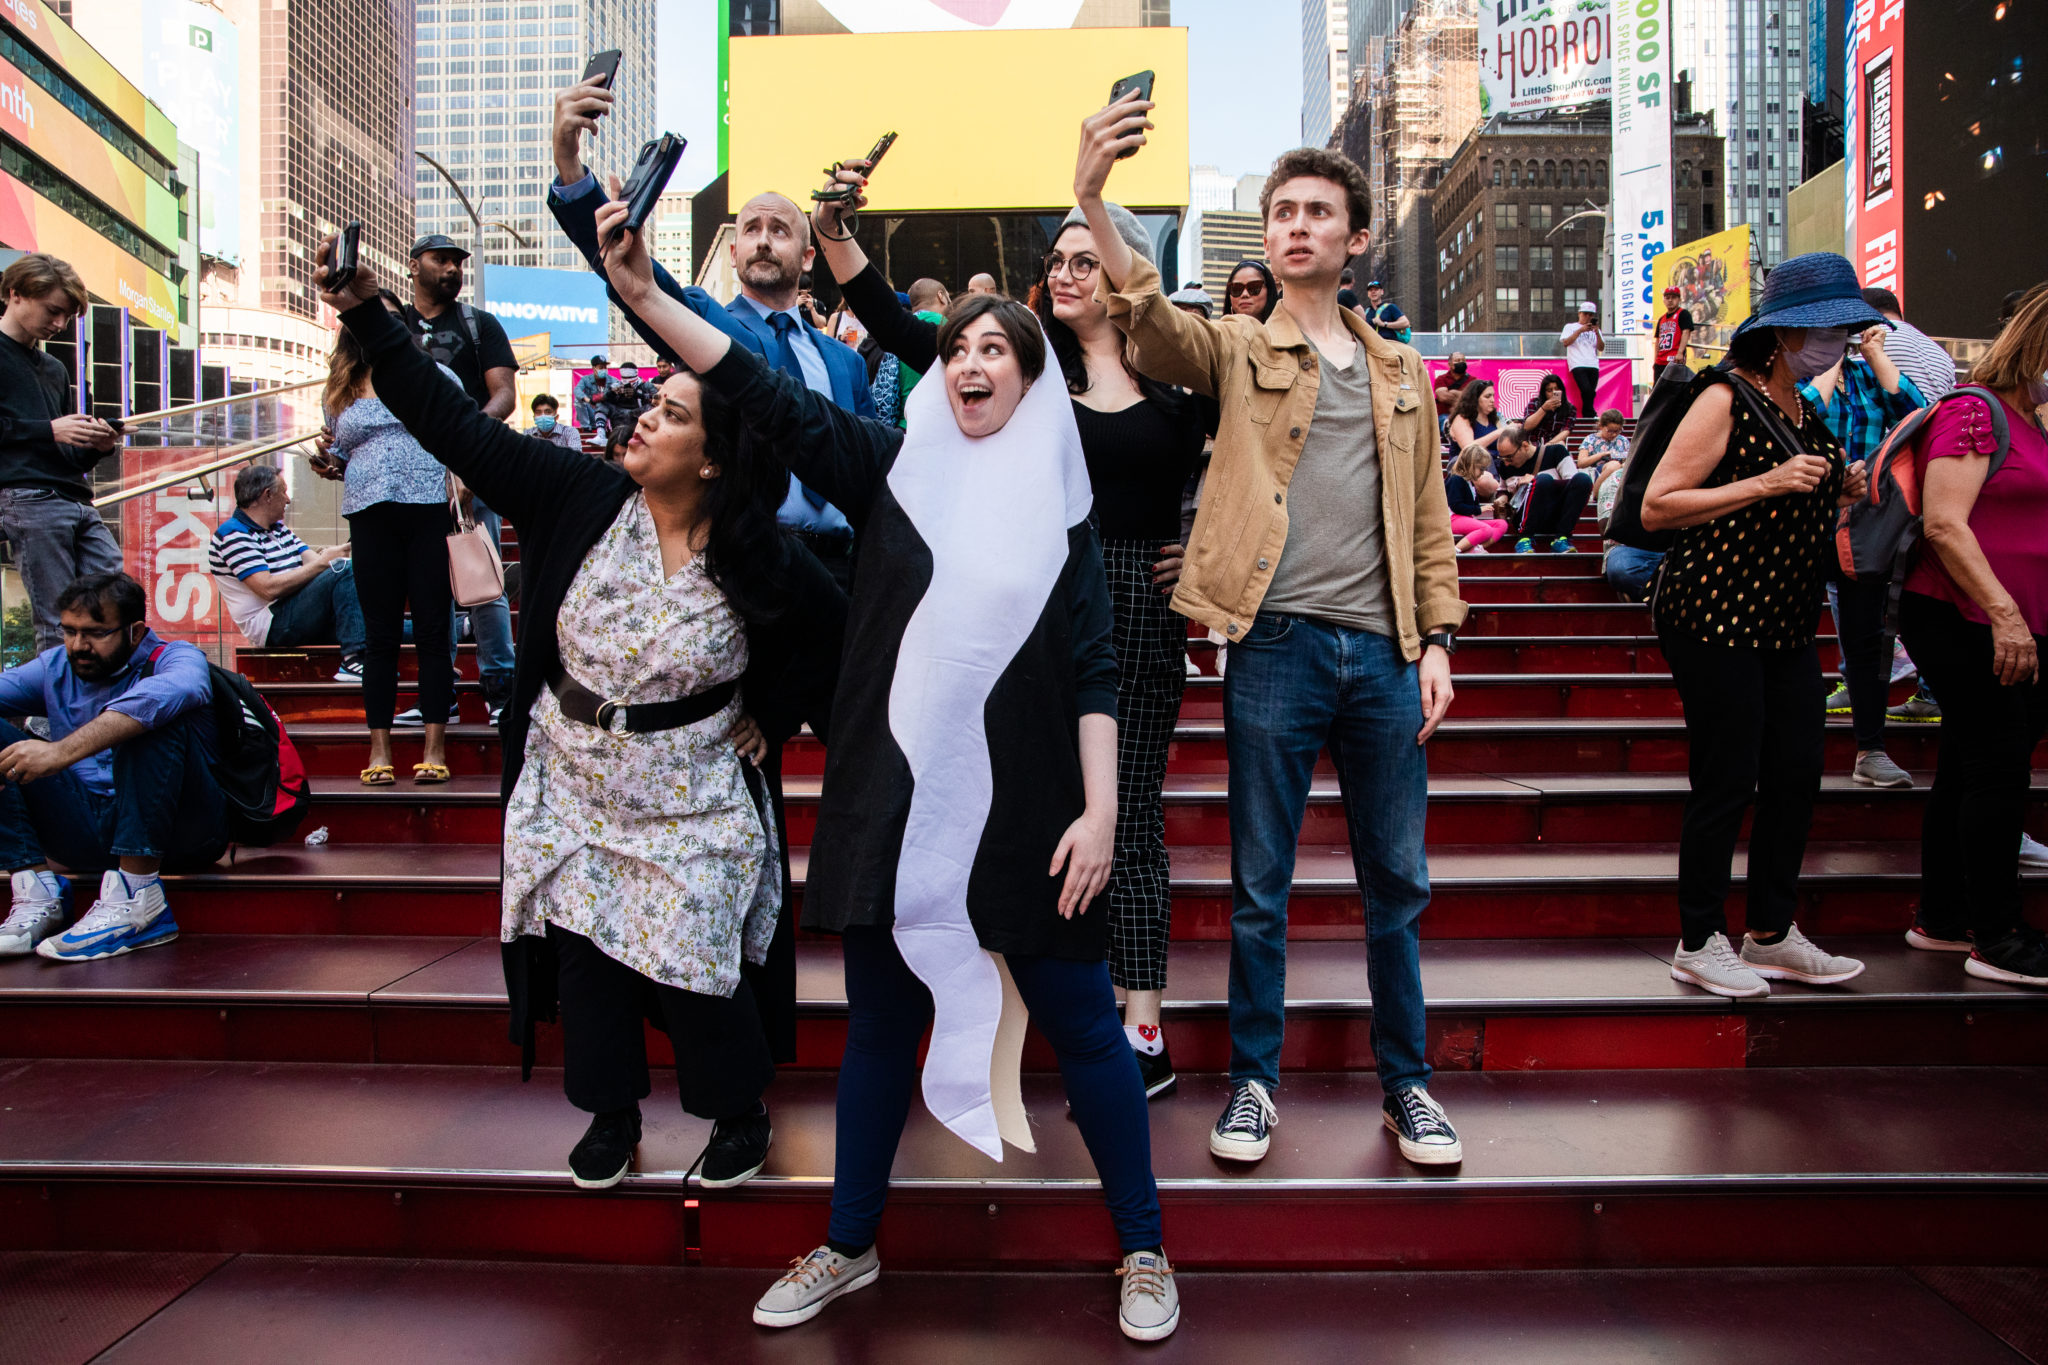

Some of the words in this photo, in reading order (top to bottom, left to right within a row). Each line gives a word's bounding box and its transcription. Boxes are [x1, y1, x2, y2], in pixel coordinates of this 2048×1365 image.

[1497, 14, 1611, 99] HORRO
[1617, 24, 1631, 63] SPACE
[1618, 67, 1632, 135] AVAILABLE
[1637, 72, 1661, 109] SF
[1873, 66, 1891, 187] HERSHEY'S
[1621, 233, 1633, 247] OF
[1621, 253, 1634, 275] LED
[119, 278, 148, 310] Morgan
[149, 296, 175, 329] Stanley
[485, 301, 598, 324] INNOVATIVE
[1622, 279, 1635, 334] SIGNAGE
[1659, 332, 1674, 351] 23
